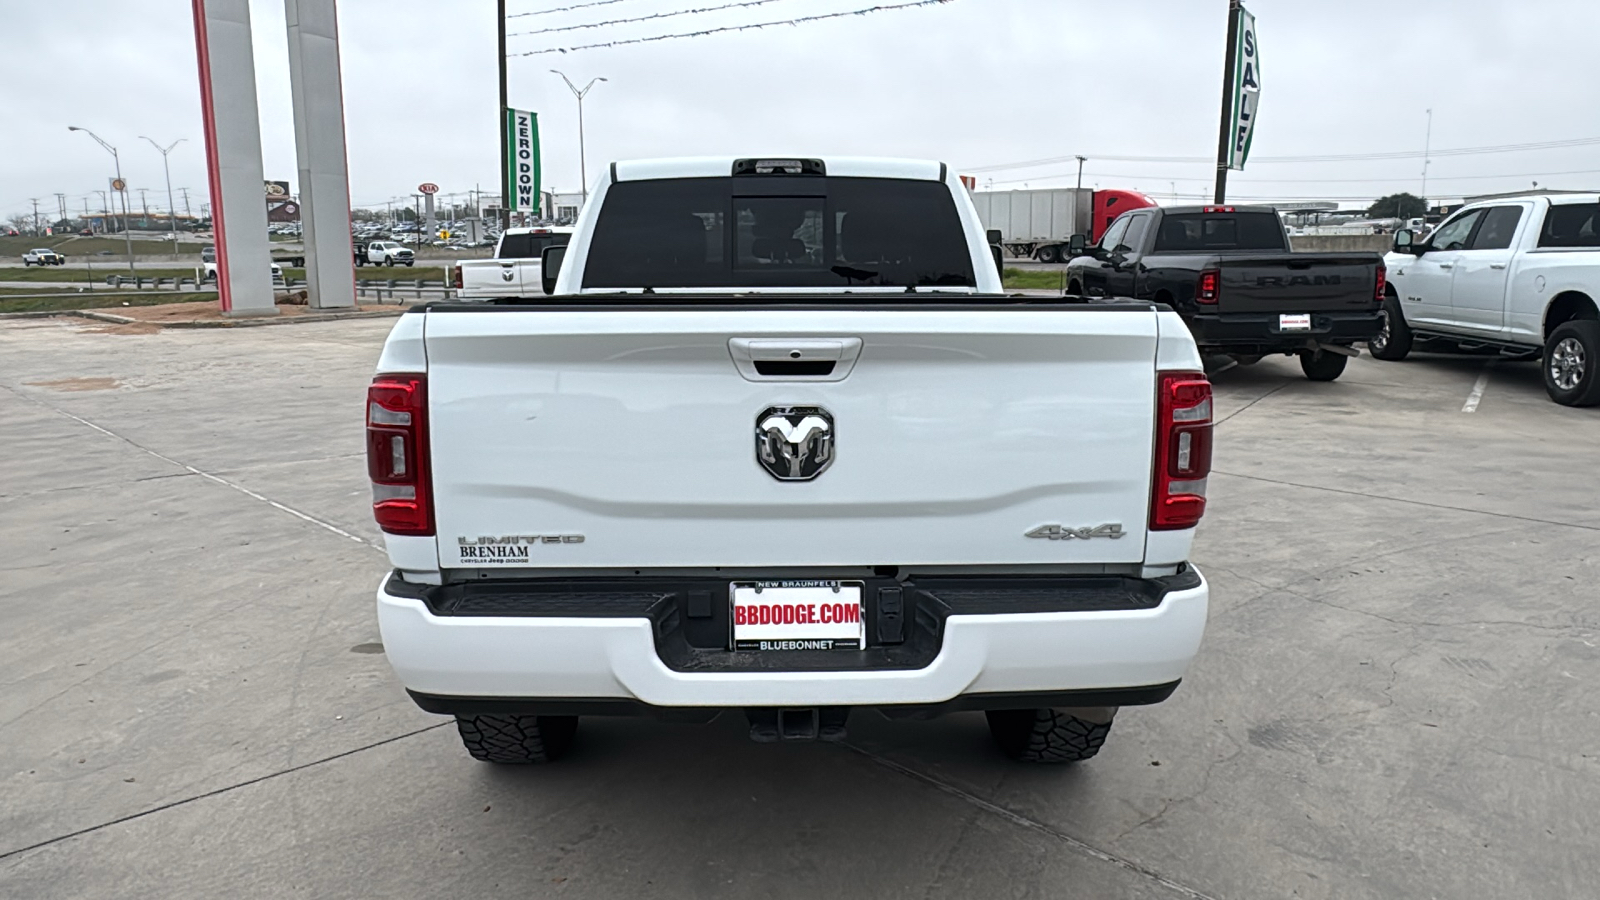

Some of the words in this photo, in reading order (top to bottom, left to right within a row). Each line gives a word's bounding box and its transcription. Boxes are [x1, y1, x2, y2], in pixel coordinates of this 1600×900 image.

[1236, 29, 1258, 153] SALE
[518, 116, 531, 160] ZERO
[518, 163, 532, 206] DOWN
[1256, 275, 1341, 287] RAM
[457, 534, 585, 545] LIMITED
[460, 546, 529, 558] BRENHAM
[735, 603, 860, 625] BBDODGE.COM
[760, 640, 834, 651] BLUEBONNET
